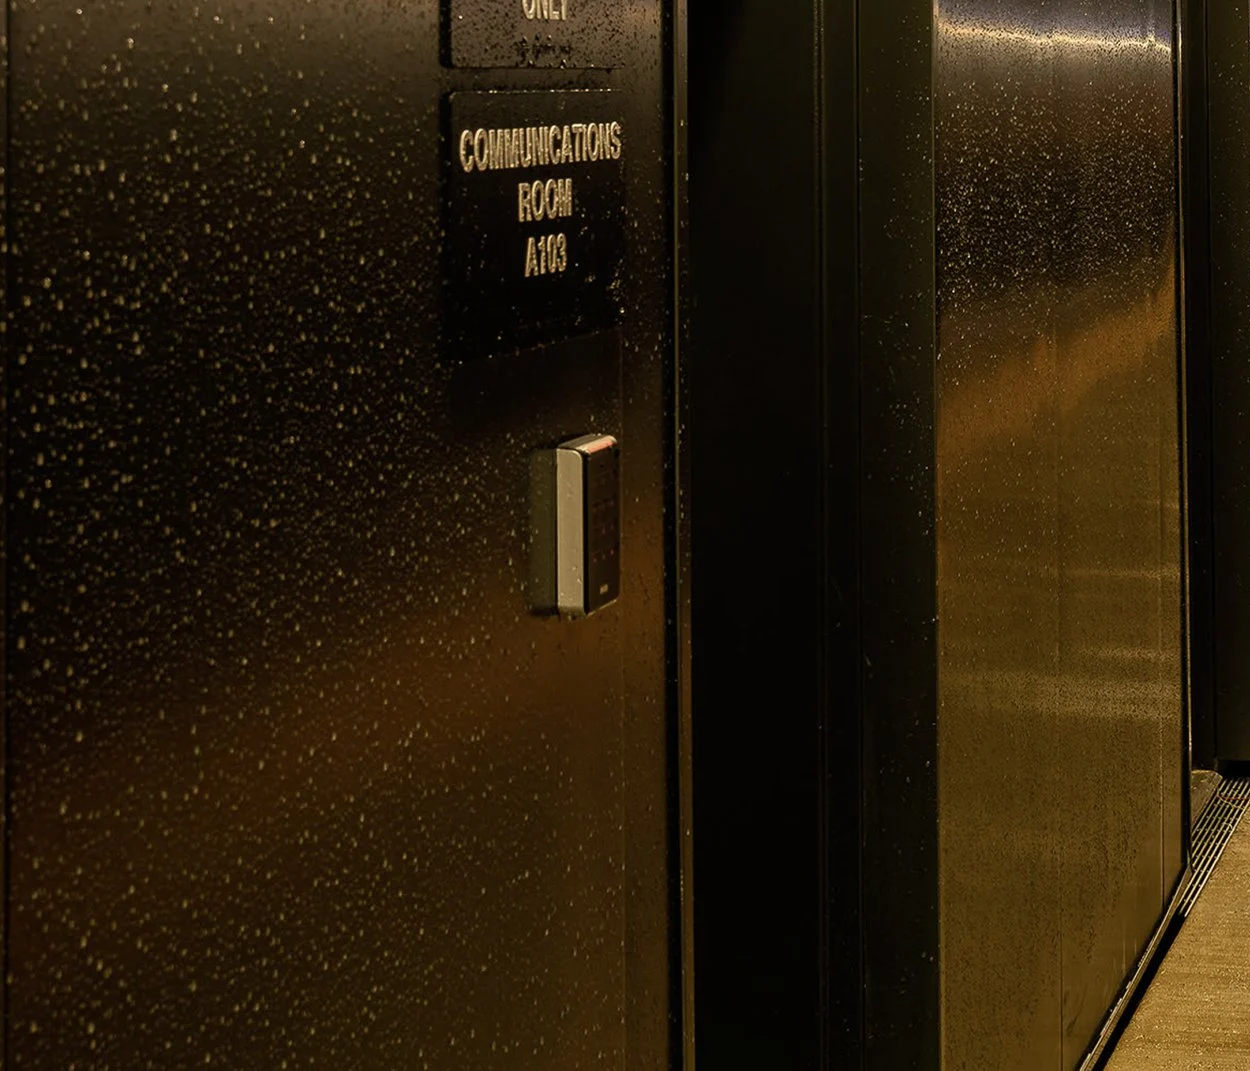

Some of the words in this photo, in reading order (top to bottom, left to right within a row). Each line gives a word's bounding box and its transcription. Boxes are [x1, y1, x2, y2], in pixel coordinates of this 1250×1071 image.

[459, 121, 622, 173] COMMUNICATIONS
[518, 178, 572, 222] ROOM
[524, 232, 567, 278] A103
